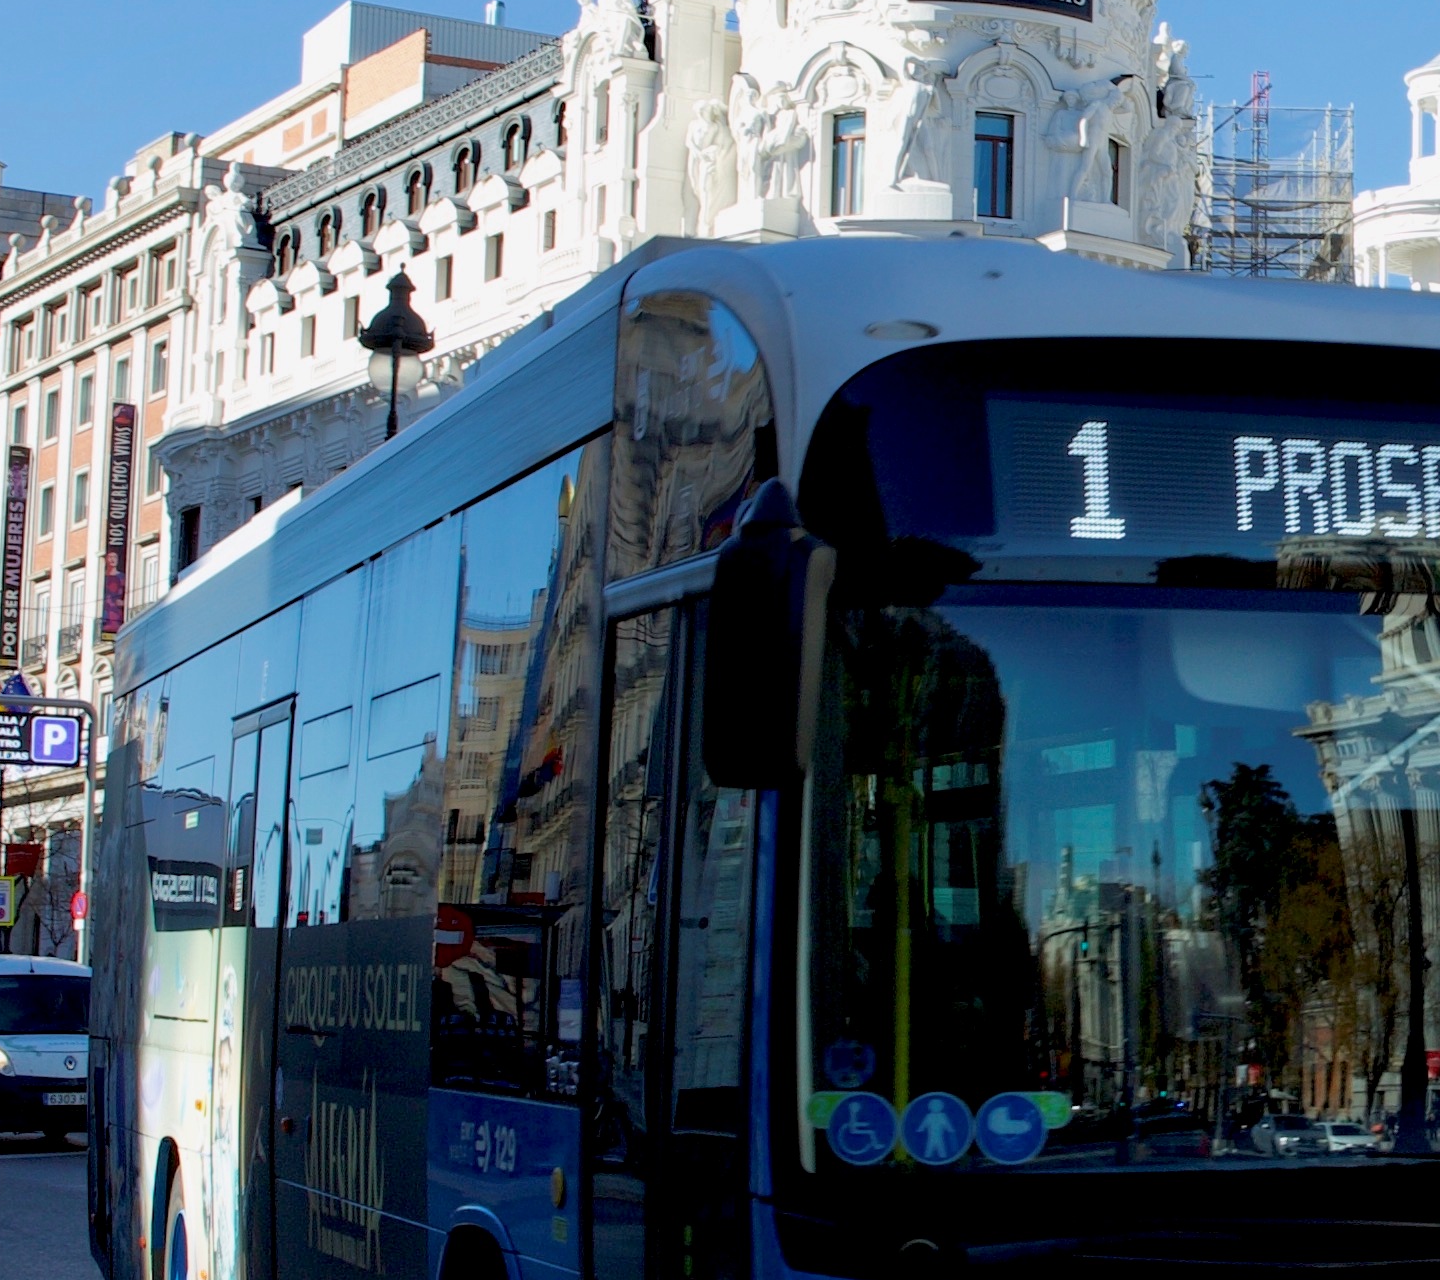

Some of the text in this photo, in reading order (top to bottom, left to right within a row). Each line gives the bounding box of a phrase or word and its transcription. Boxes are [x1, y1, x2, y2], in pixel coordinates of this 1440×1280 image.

[109, 426, 132, 546] NOS QUEREMOS VIVAS
[1067, 420, 1126, 540] 1
[2, 500, 24, 656] POR SER MUJERES
[44, 723, 67, 756] P
[286, 964, 422, 1047] CIRQUE DU SOLEIL
[50, 1093, 77, 1104] 6303
[495, 1125, 516, 1172] 129
